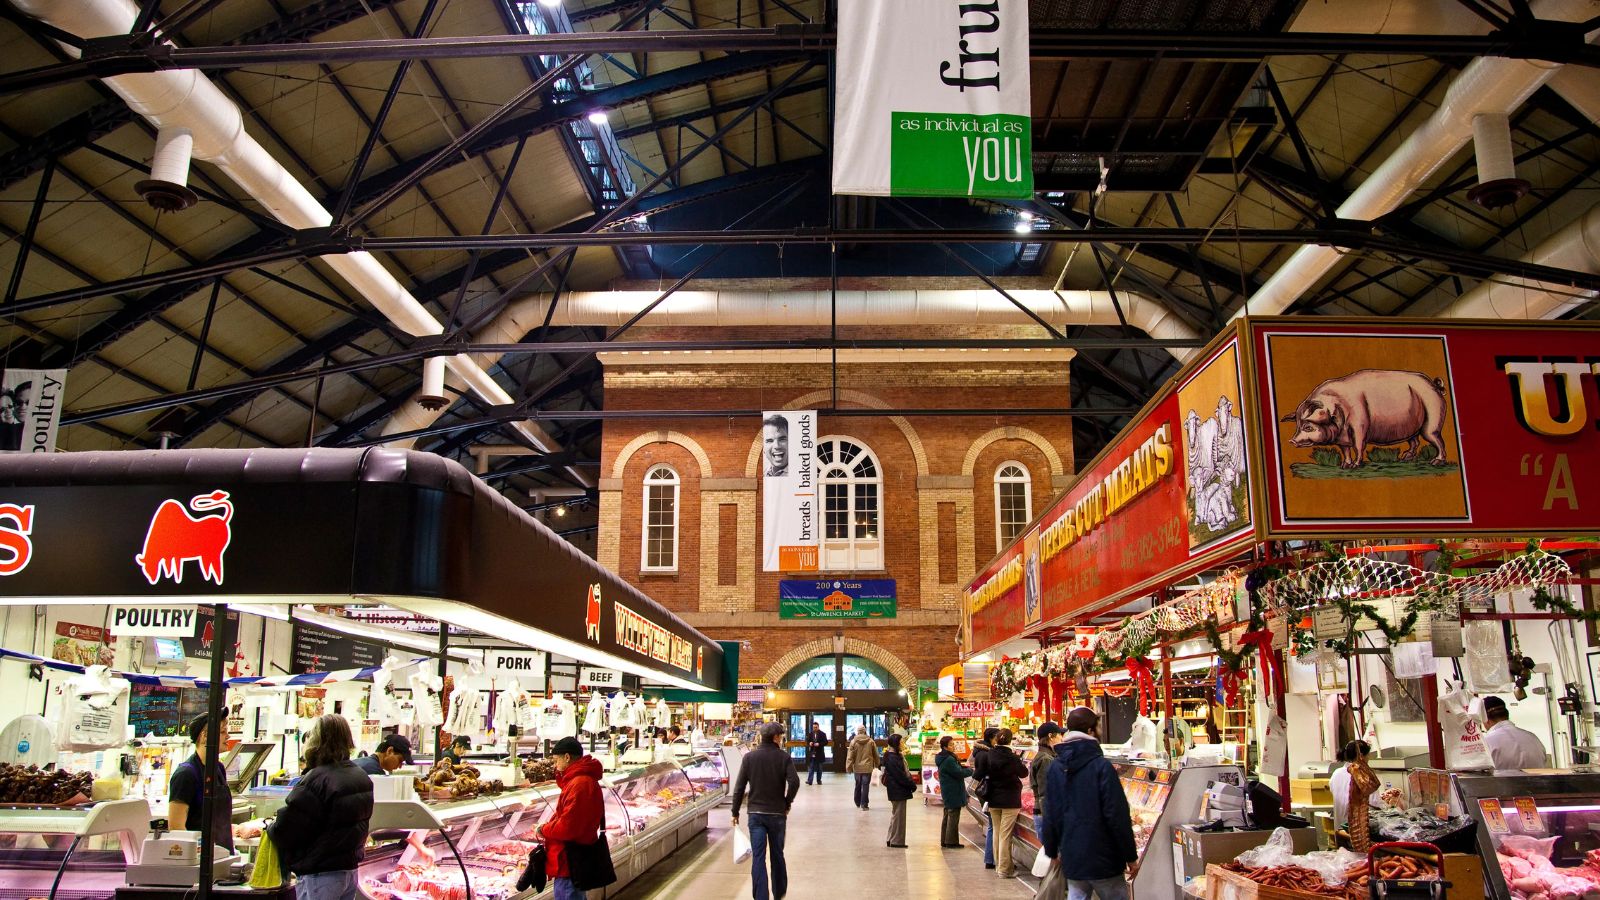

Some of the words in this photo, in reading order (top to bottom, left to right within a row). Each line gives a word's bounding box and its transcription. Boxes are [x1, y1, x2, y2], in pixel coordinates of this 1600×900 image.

[900, 119, 920, 130] as
[924, 117, 999, 133] individual
[1003, 120, 1023, 133] as
[963, 136, 1022, 195] you
[798, 414, 813, 449] goods
[799, 452, 811, 489] baked
[1039, 509, 1077, 563] UPPER
[1076, 484, 1106, 538] CUT
[1104, 424, 1174, 517] MEATS
[799, 500, 811, 541] breads
[843, 581, 862, 589] Years
[114, 608, 194, 627] POULTRY
[366, 613, 410, 625] History
[614, 601, 671, 665] WITTEVEEN
[670, 632, 693, 673] MEATS
[496, 656, 532, 670] PORK
[589, 671, 613, 682] BEEF
[952, 702, 994, 712] TAKE-OUT
